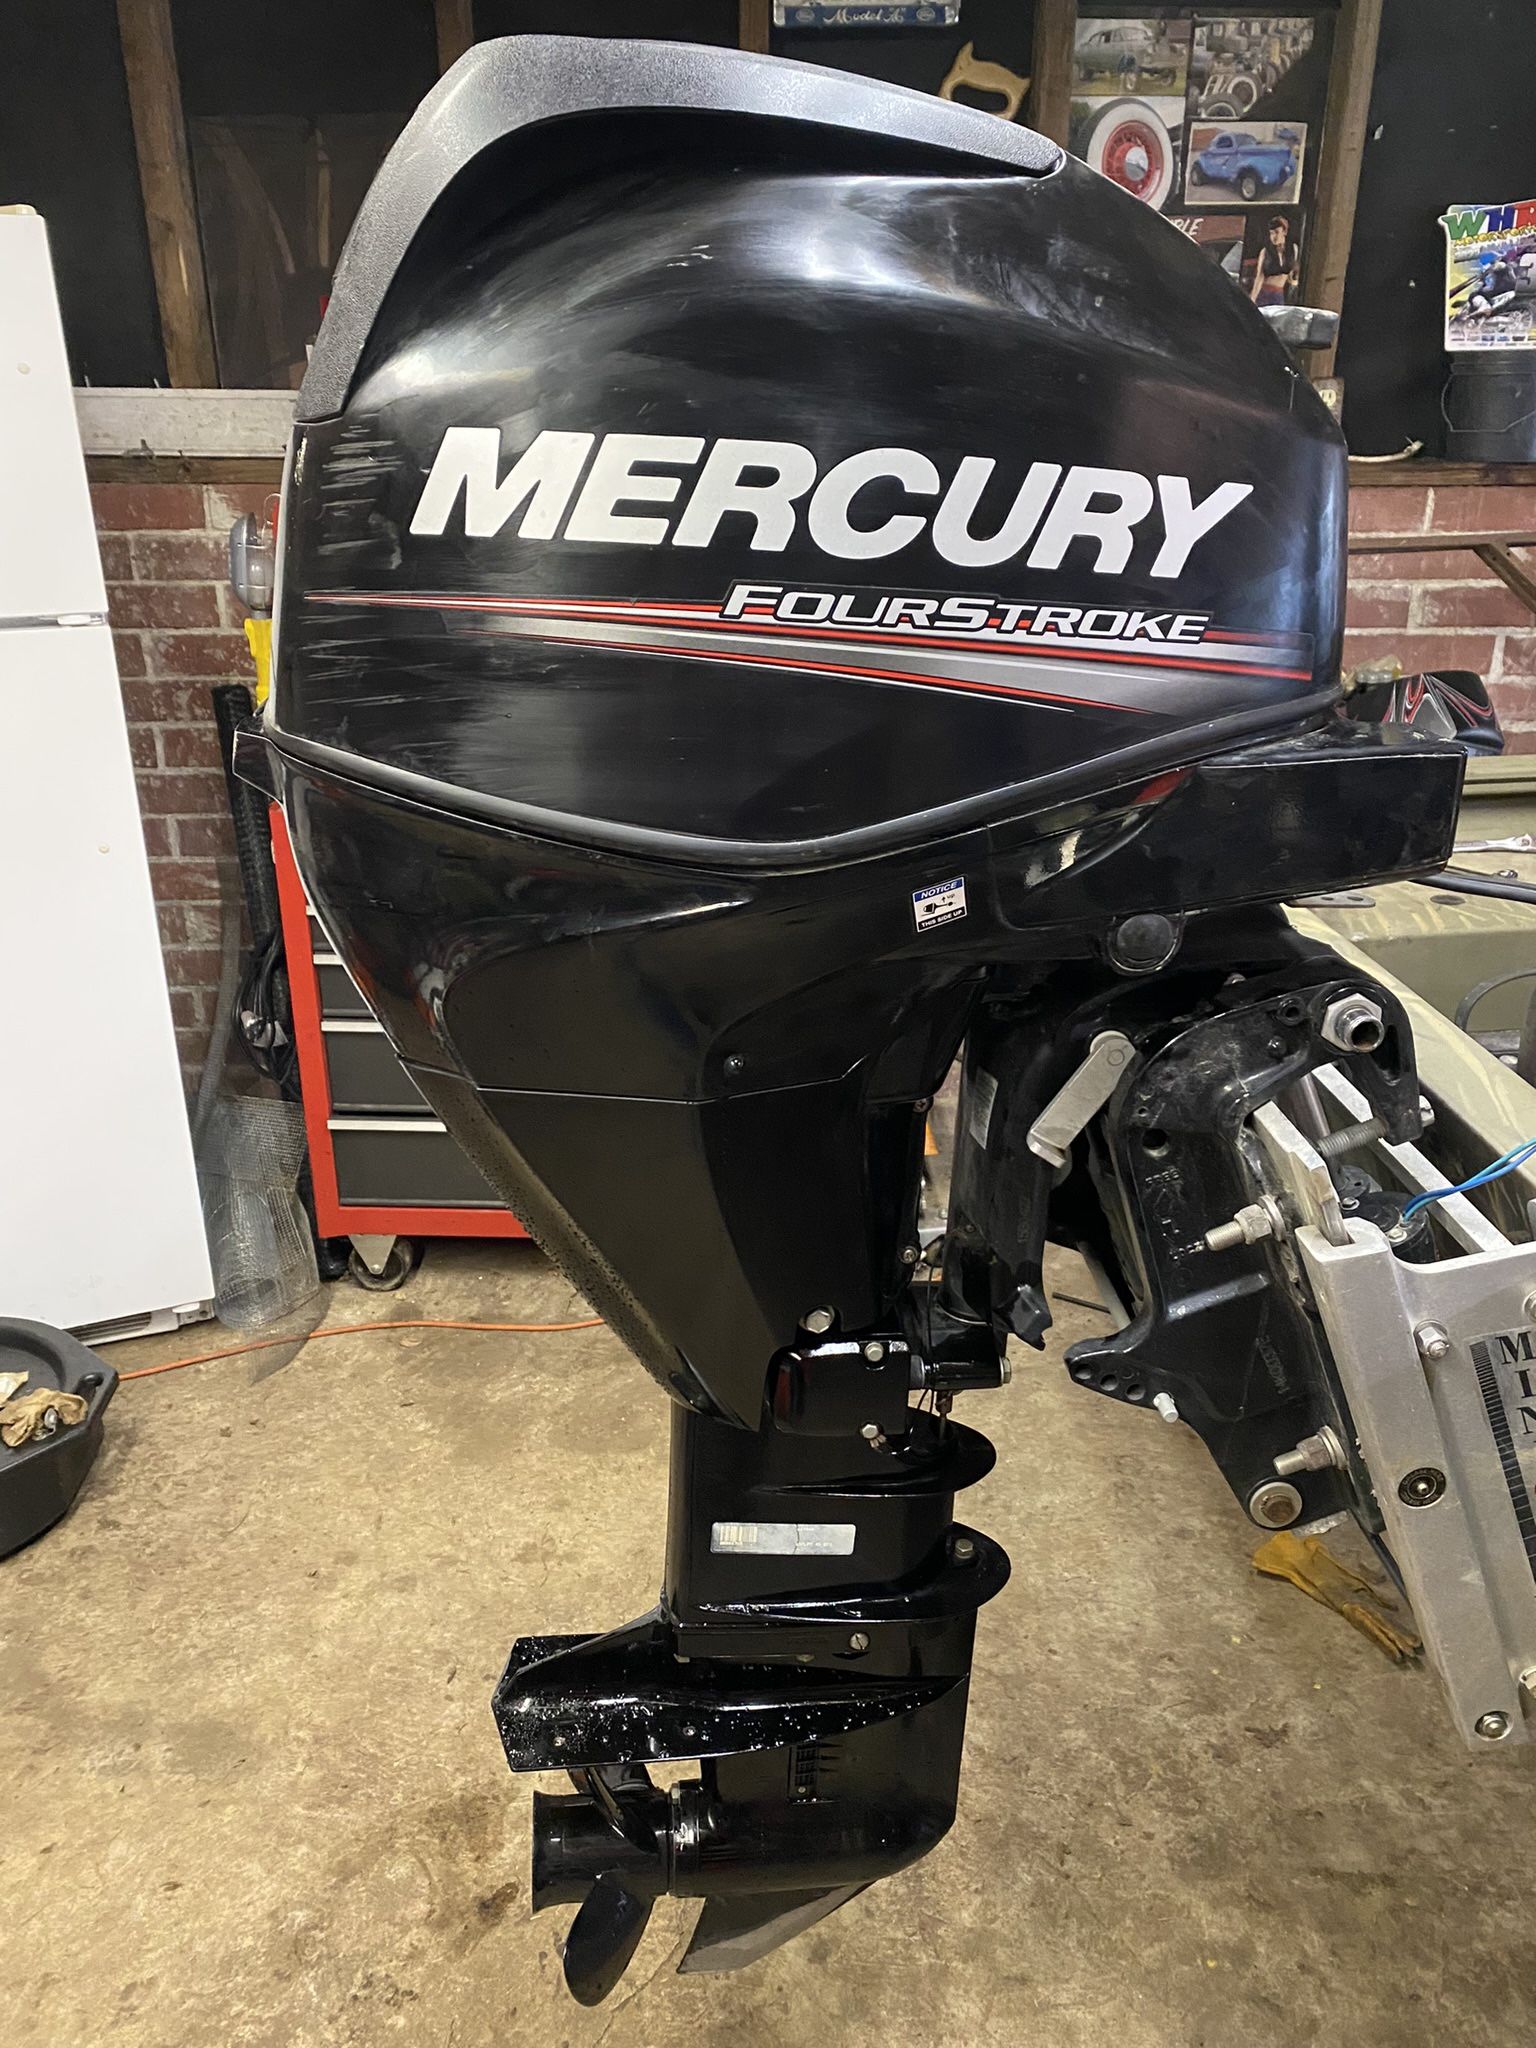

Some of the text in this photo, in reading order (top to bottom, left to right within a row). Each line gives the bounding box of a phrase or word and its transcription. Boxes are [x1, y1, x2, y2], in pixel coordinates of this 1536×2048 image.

[823, 8, 883, 24] Model
[409, 426, 1254, 578] MERCURY
[721, 583, 1209, 642] FOURSTROKE
[921, 881, 958, 899] NOTICE
[921, 909, 963, 928] THIS SIDE UP
